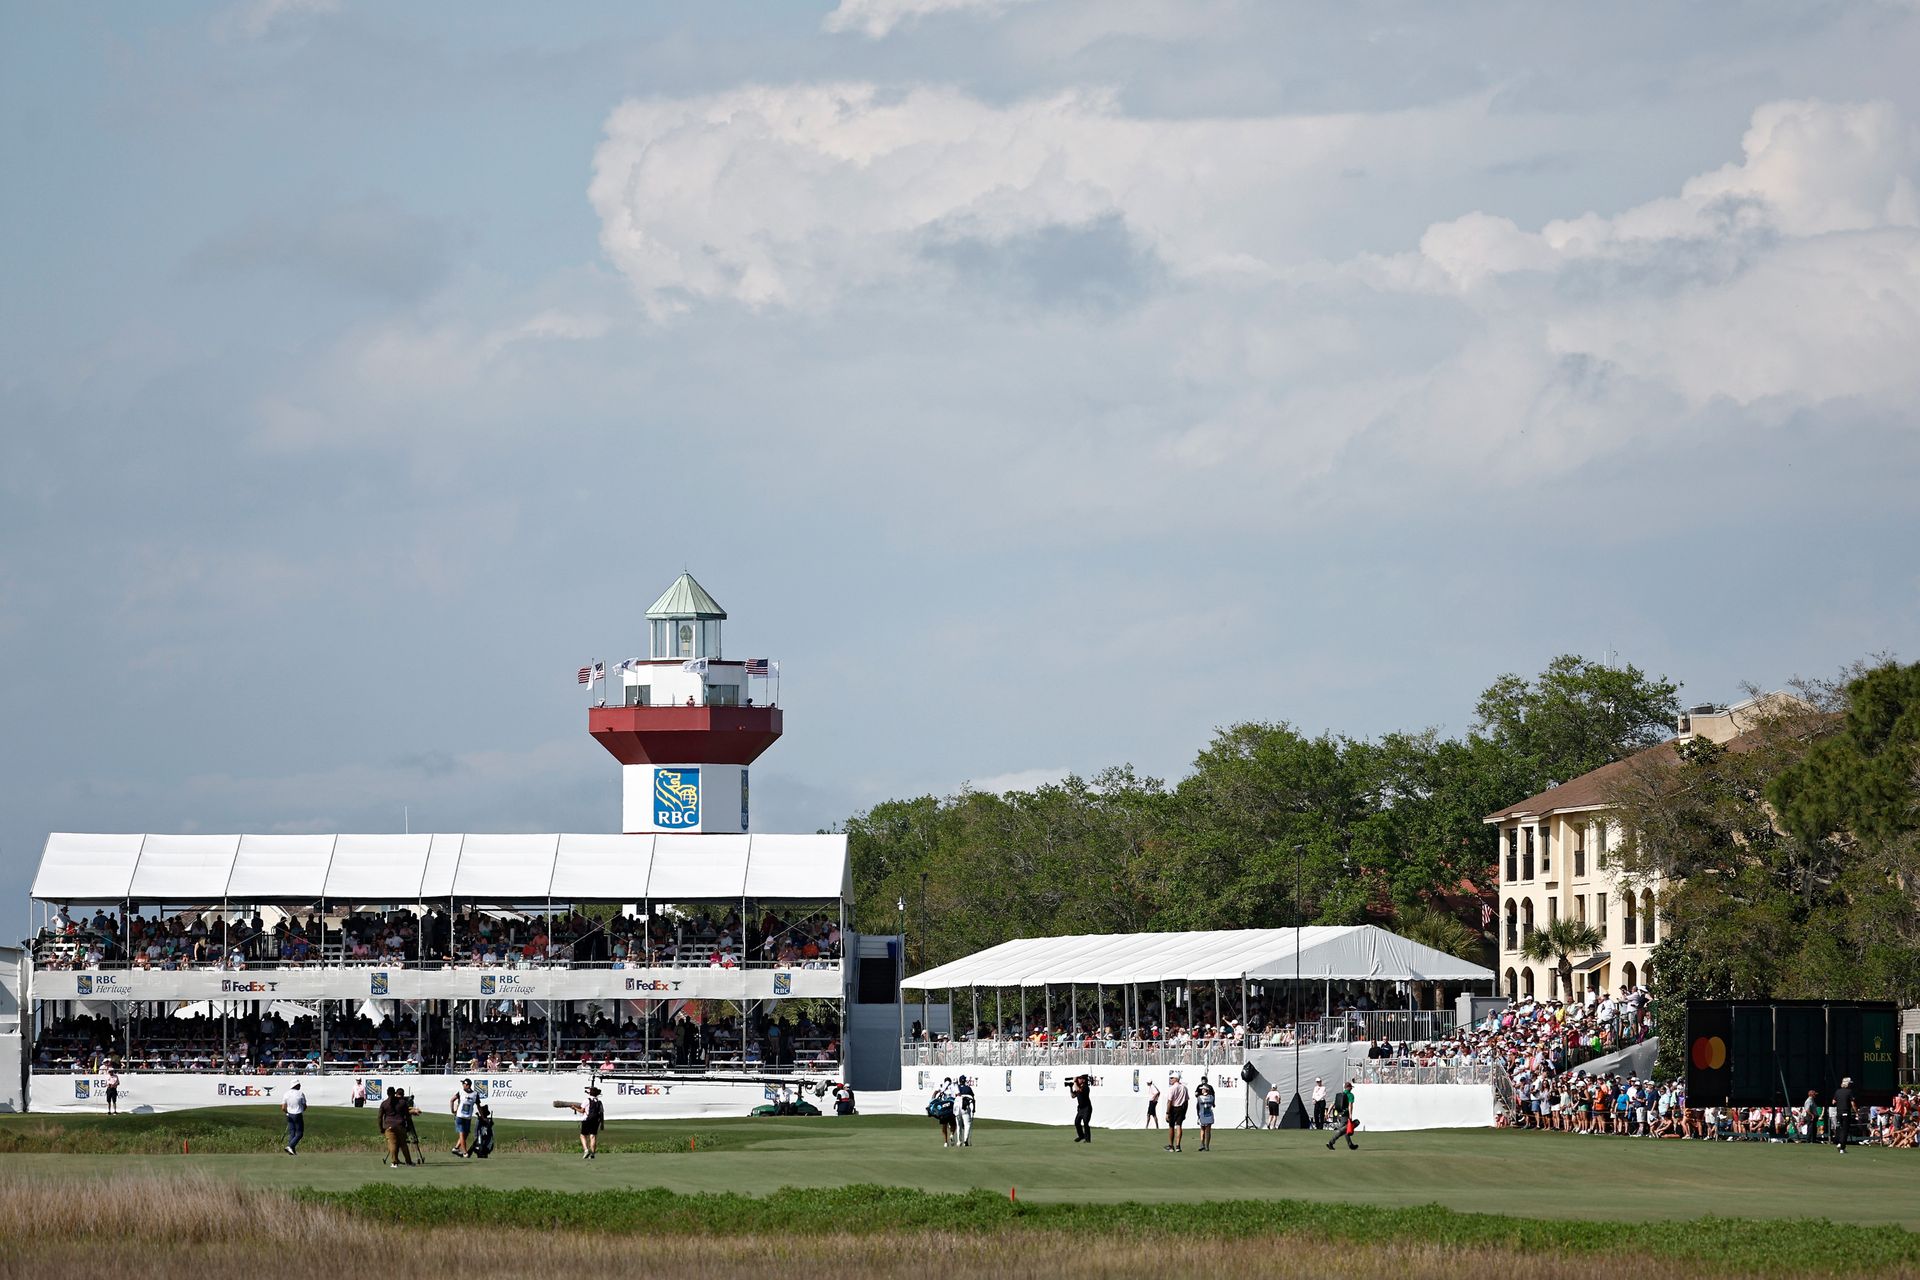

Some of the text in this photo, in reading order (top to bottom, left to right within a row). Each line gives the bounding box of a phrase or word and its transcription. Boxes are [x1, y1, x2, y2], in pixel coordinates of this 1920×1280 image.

[658, 811, 695, 824] RBC
[96, 975, 117, 984] RBC
[499, 975, 520, 984] RBC
[96, 985, 132, 995] Heritage
[232, 981, 266, 992] FedEx
[499, 985, 535, 995] Heritage
[636, 980, 669, 991] FedEx
[1864, 1052, 1892, 1062] ROLEX
[492, 1080, 512, 1088] RBC
[229, 1086, 261, 1096] FedEx
[491, 1089, 528, 1099] Heritage
[628, 1085, 660, 1095] FedEx
